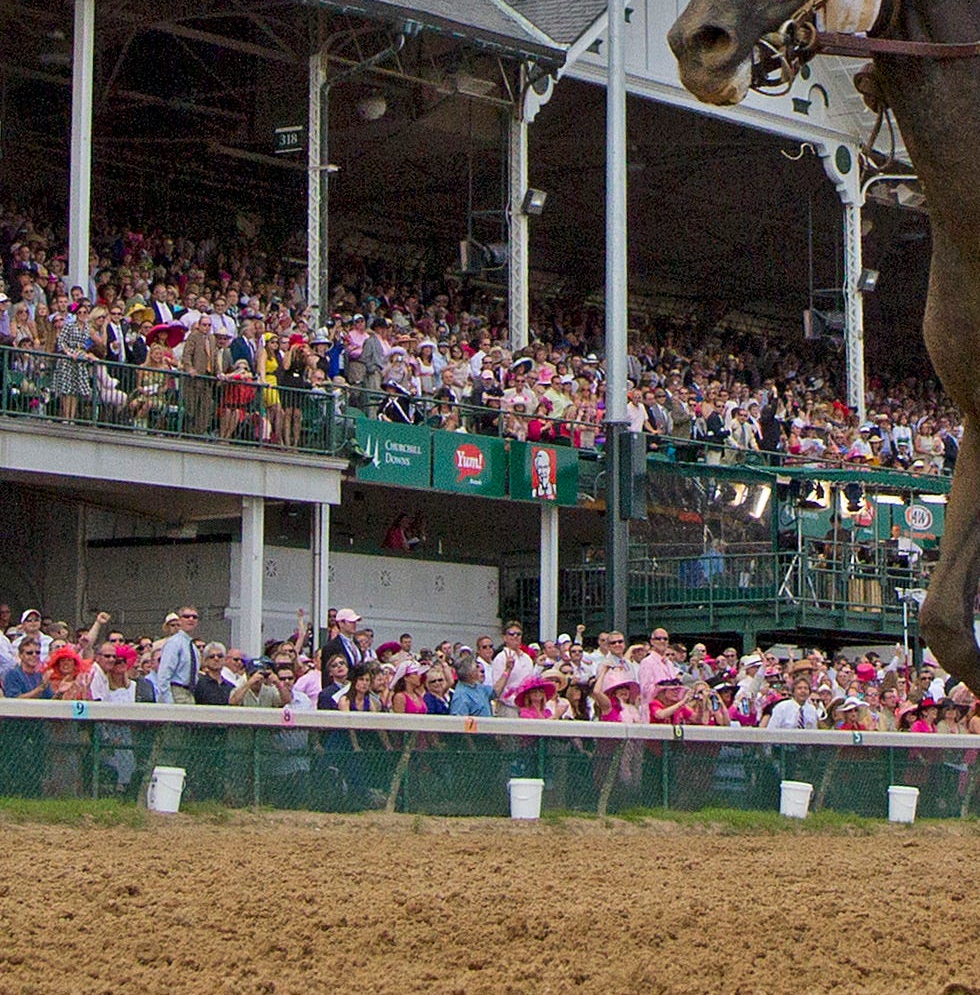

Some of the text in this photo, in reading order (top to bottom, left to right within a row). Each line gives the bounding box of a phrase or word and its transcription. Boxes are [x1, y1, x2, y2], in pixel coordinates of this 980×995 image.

[279, 133, 298, 146] 318
[456, 450, 483, 470] Yum!
[76, 702, 85, 716] 9
[283, 708, 291, 722] 8
[467, 717, 475, 730] 7
[675, 725, 683, 738] 6
[854, 732, 861, 743] 5
